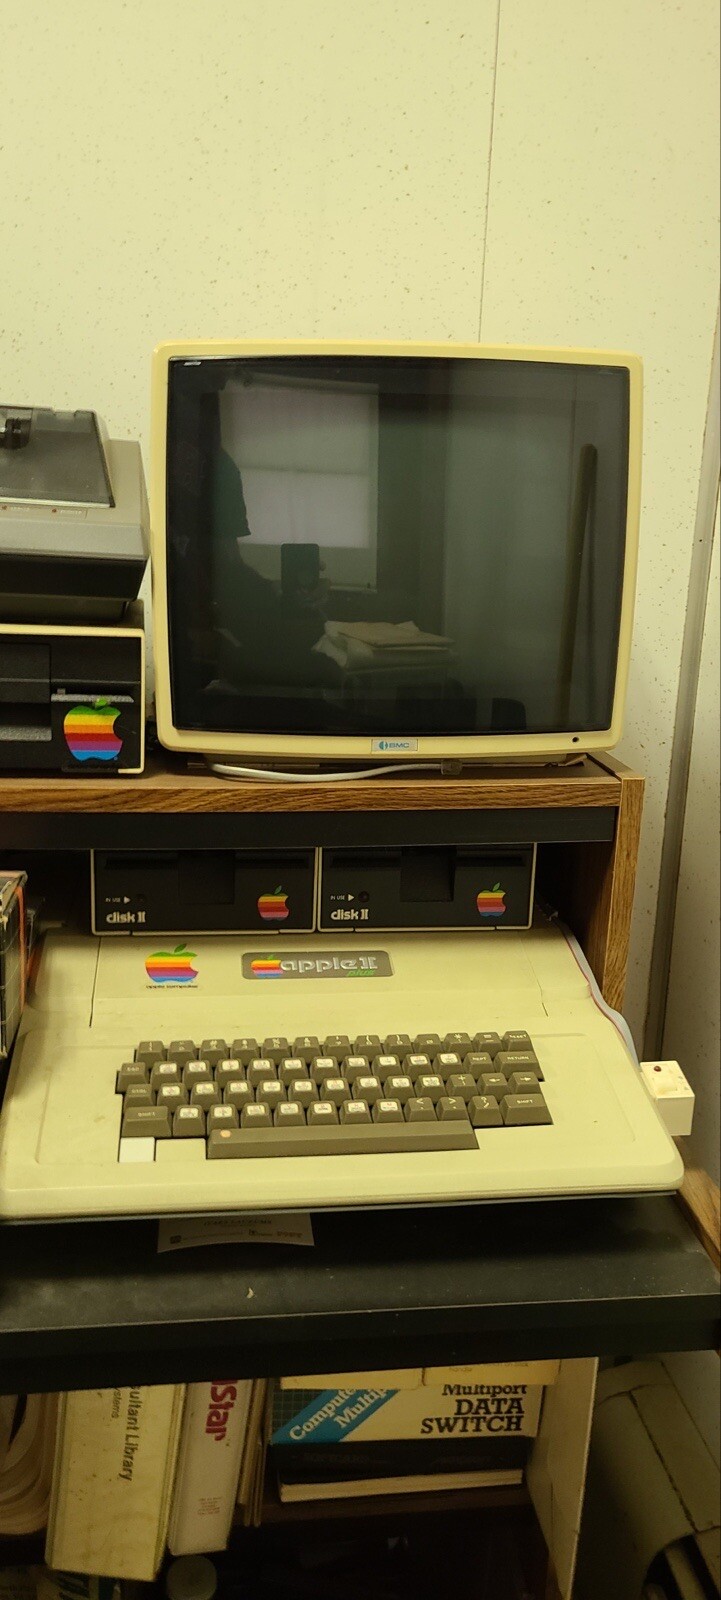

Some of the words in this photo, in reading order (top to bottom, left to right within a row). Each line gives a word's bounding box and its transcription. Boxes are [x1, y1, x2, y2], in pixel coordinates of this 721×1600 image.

[106, 911, 135, 923] disk
[330, 908, 359, 920] disk
[280, 957, 357, 974] apple
[441, 1385, 527, 1399] Multiport
[454, 1398, 525, 1415] DATA
[420, 1415, 524, 1435] SWITCH
[119, 1434, 140, 1482] Library
